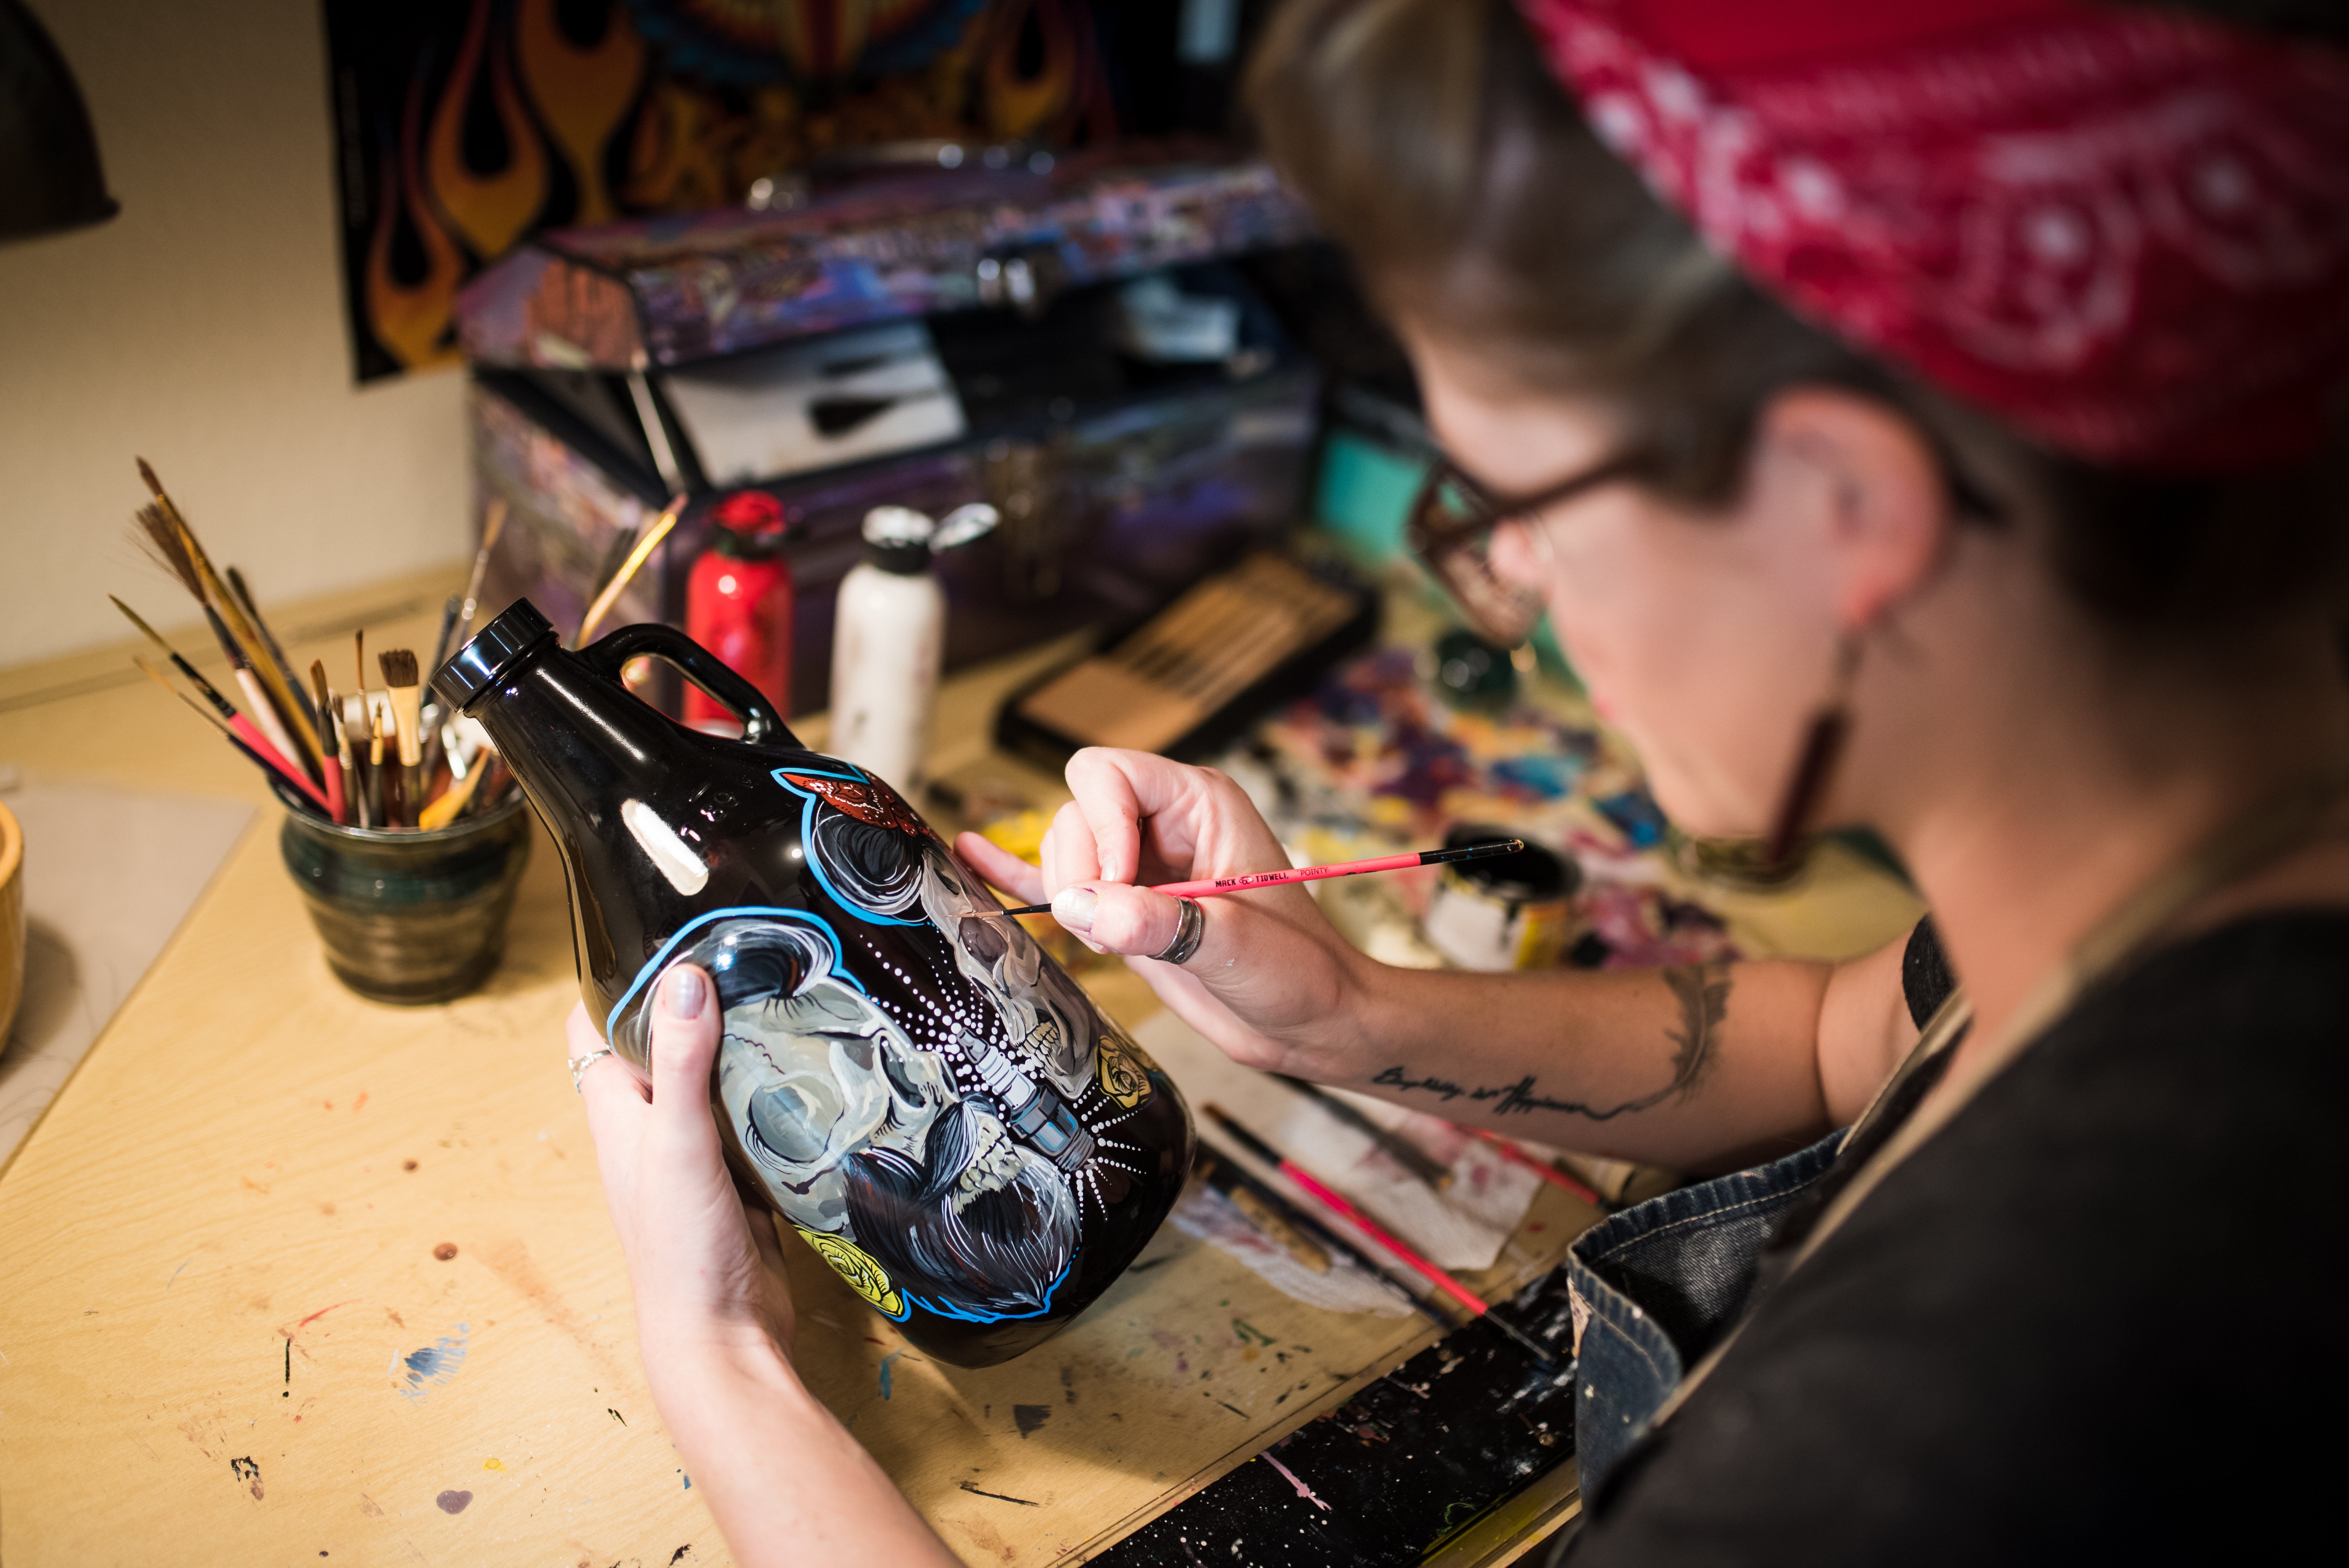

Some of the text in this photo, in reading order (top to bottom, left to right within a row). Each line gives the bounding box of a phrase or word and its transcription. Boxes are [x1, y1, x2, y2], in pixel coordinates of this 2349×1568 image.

[1215, 867, 1328, 888] MACK TIDWELL POINTY
